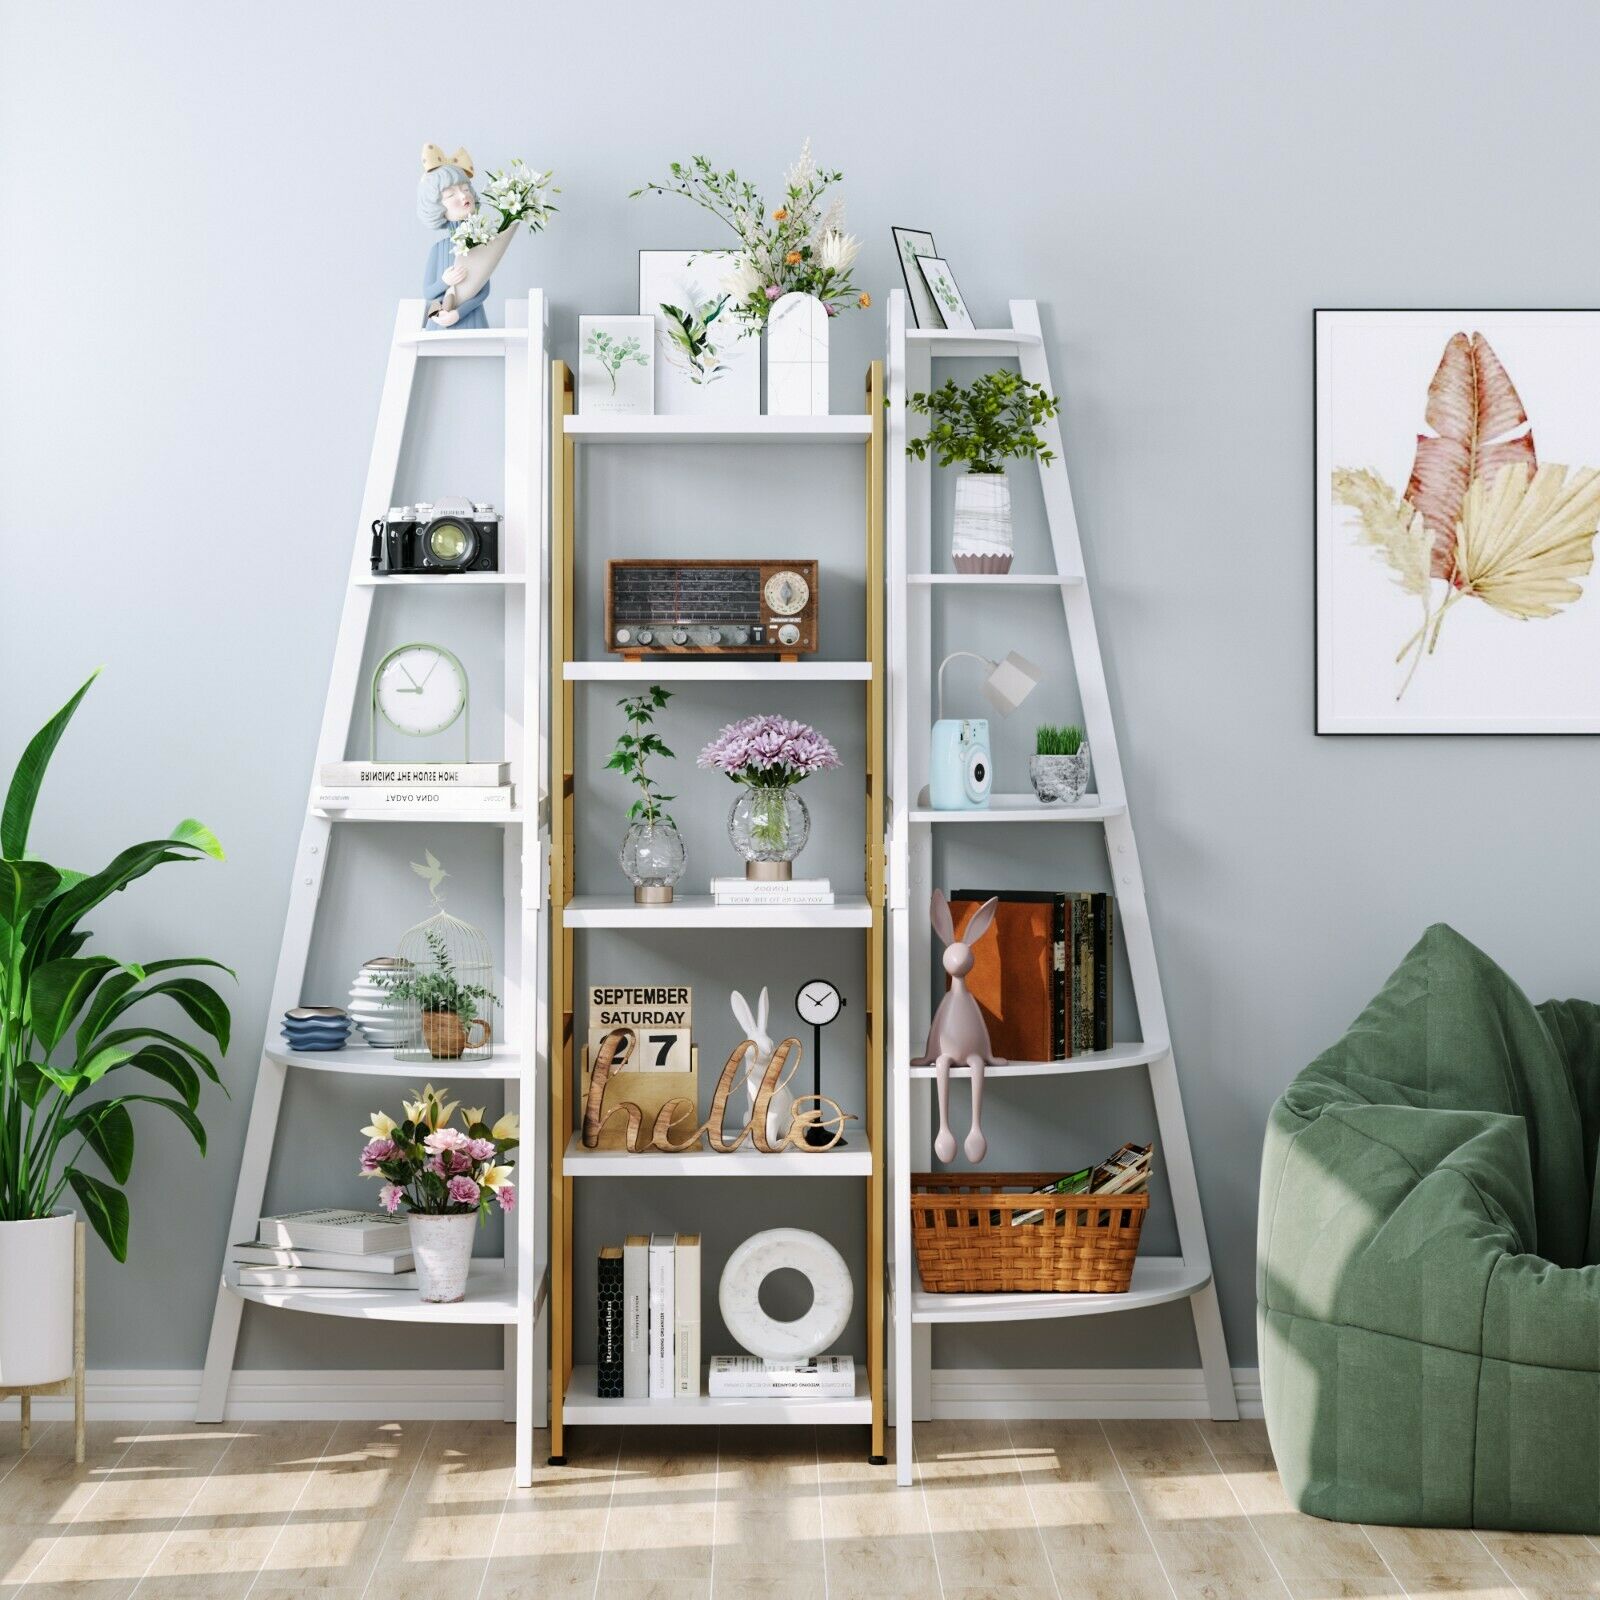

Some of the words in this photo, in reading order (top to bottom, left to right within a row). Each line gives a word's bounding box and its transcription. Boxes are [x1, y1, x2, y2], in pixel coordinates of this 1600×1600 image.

[593, 988, 688, 1005] SEPTEMBER
[600, 1011, 686, 1025] SATURDAY
[581, 1027, 859, 1154] hello
